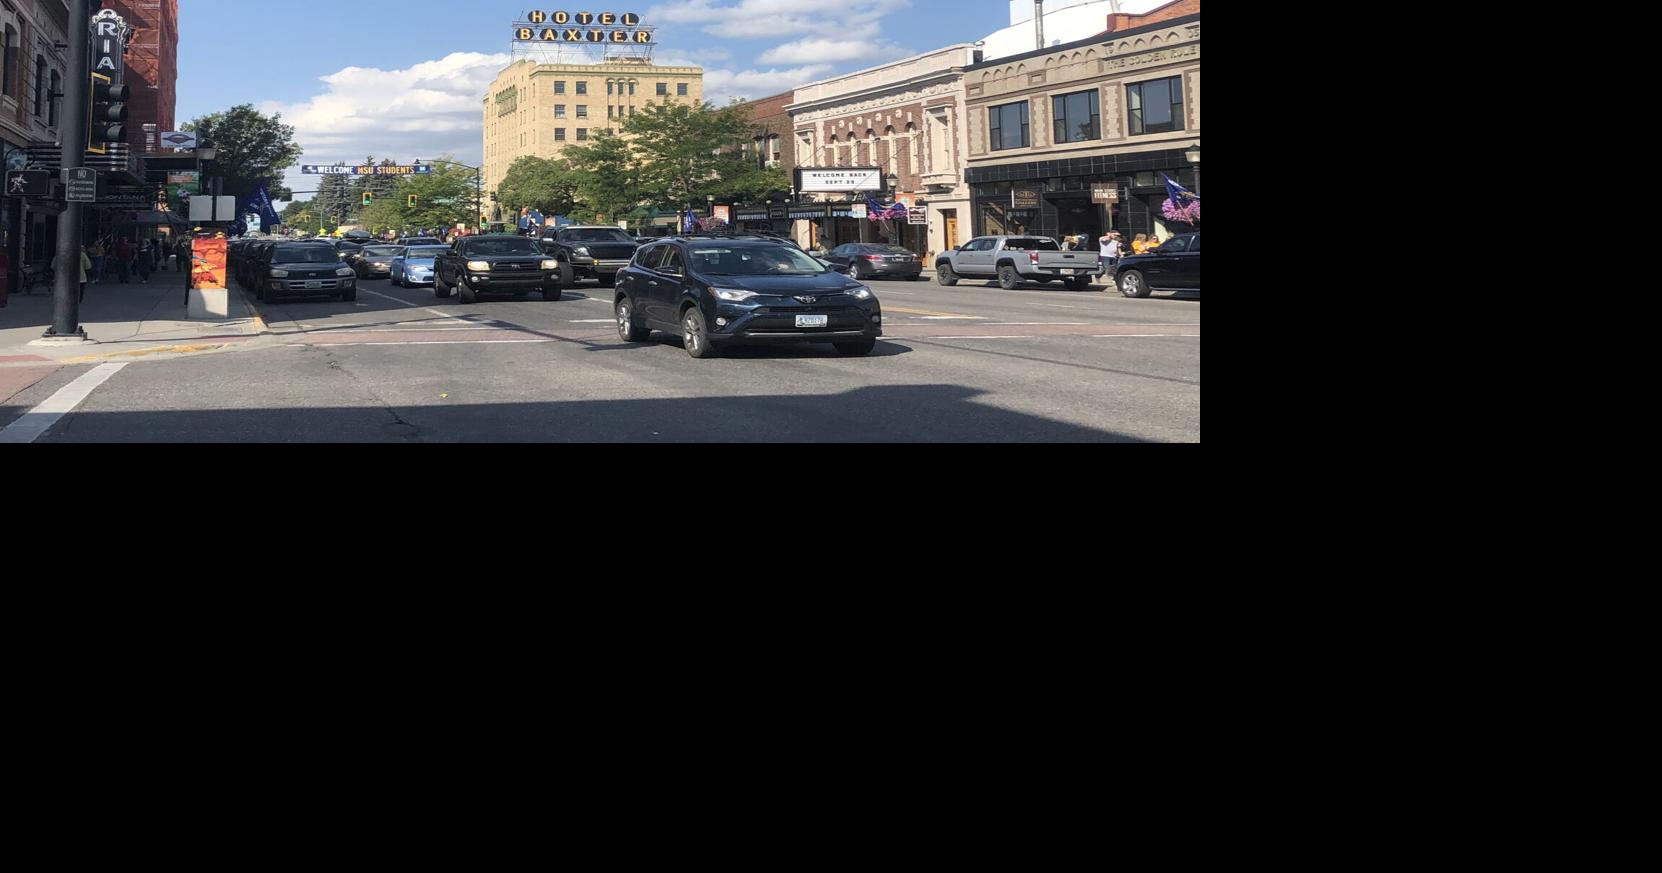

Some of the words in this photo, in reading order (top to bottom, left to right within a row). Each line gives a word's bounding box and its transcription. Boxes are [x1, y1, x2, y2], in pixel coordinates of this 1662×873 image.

[531, 10, 636, 26] HOTEL
[519, 27, 648, 43] BAXTER
[77, 169, 87, 178] NO
[317, 166, 354, 174] WELCOME
[376, 166, 415, 175] STUDENTS
